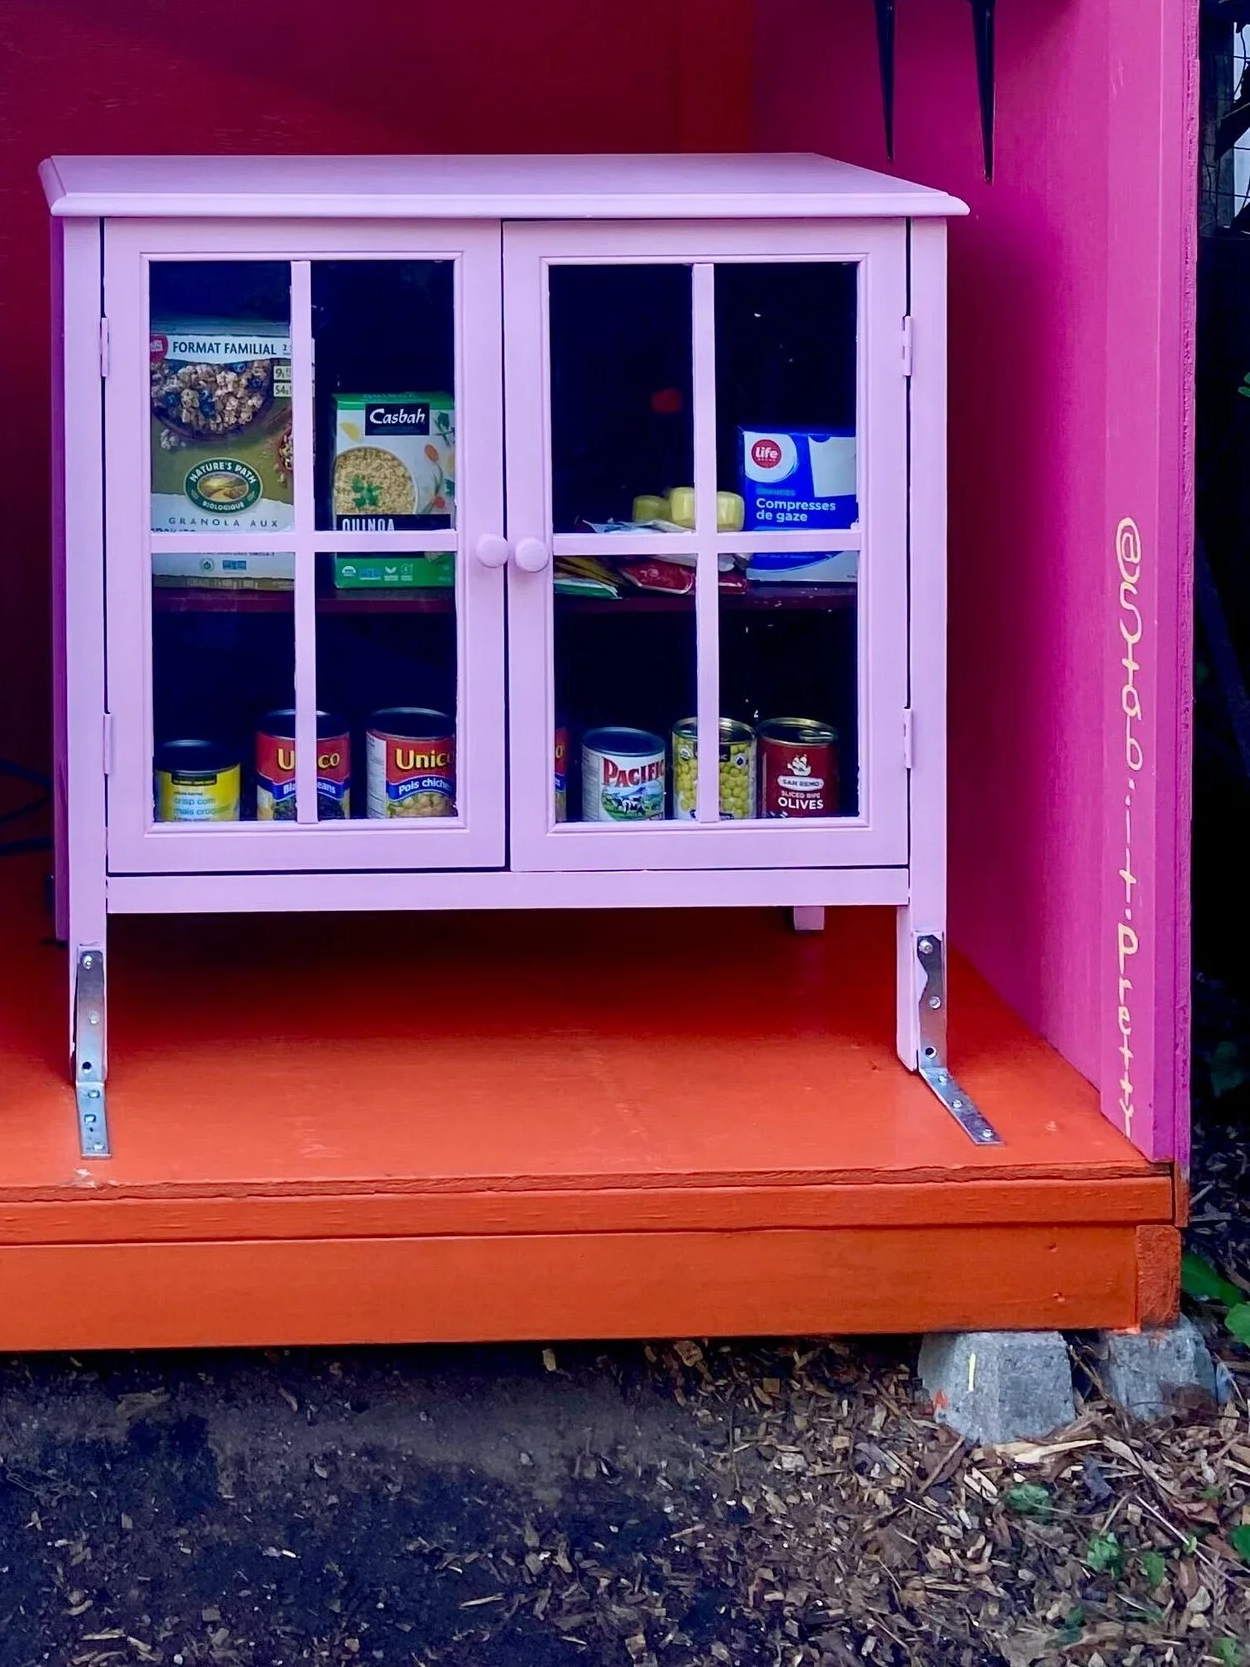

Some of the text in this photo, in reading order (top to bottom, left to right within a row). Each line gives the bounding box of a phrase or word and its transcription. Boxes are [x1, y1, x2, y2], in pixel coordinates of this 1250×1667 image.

[173, 342, 277, 355] FORMAT FAMILIAL
[369, 408, 425, 424] Casbah
[756, 447, 778, 459] Life
[190, 462, 256, 484] NATURE'S PATH
[202, 501, 245, 510] BIOLOGIQUE
[756, 498, 836, 511] Compresses
[756, 510, 808, 522] de gaze
[169, 518, 239, 527] GRANOLA
[278, 748, 340, 770] Uco
[781, 790, 805, 798] SLICED
[778, 797, 824, 809] OLIVES
